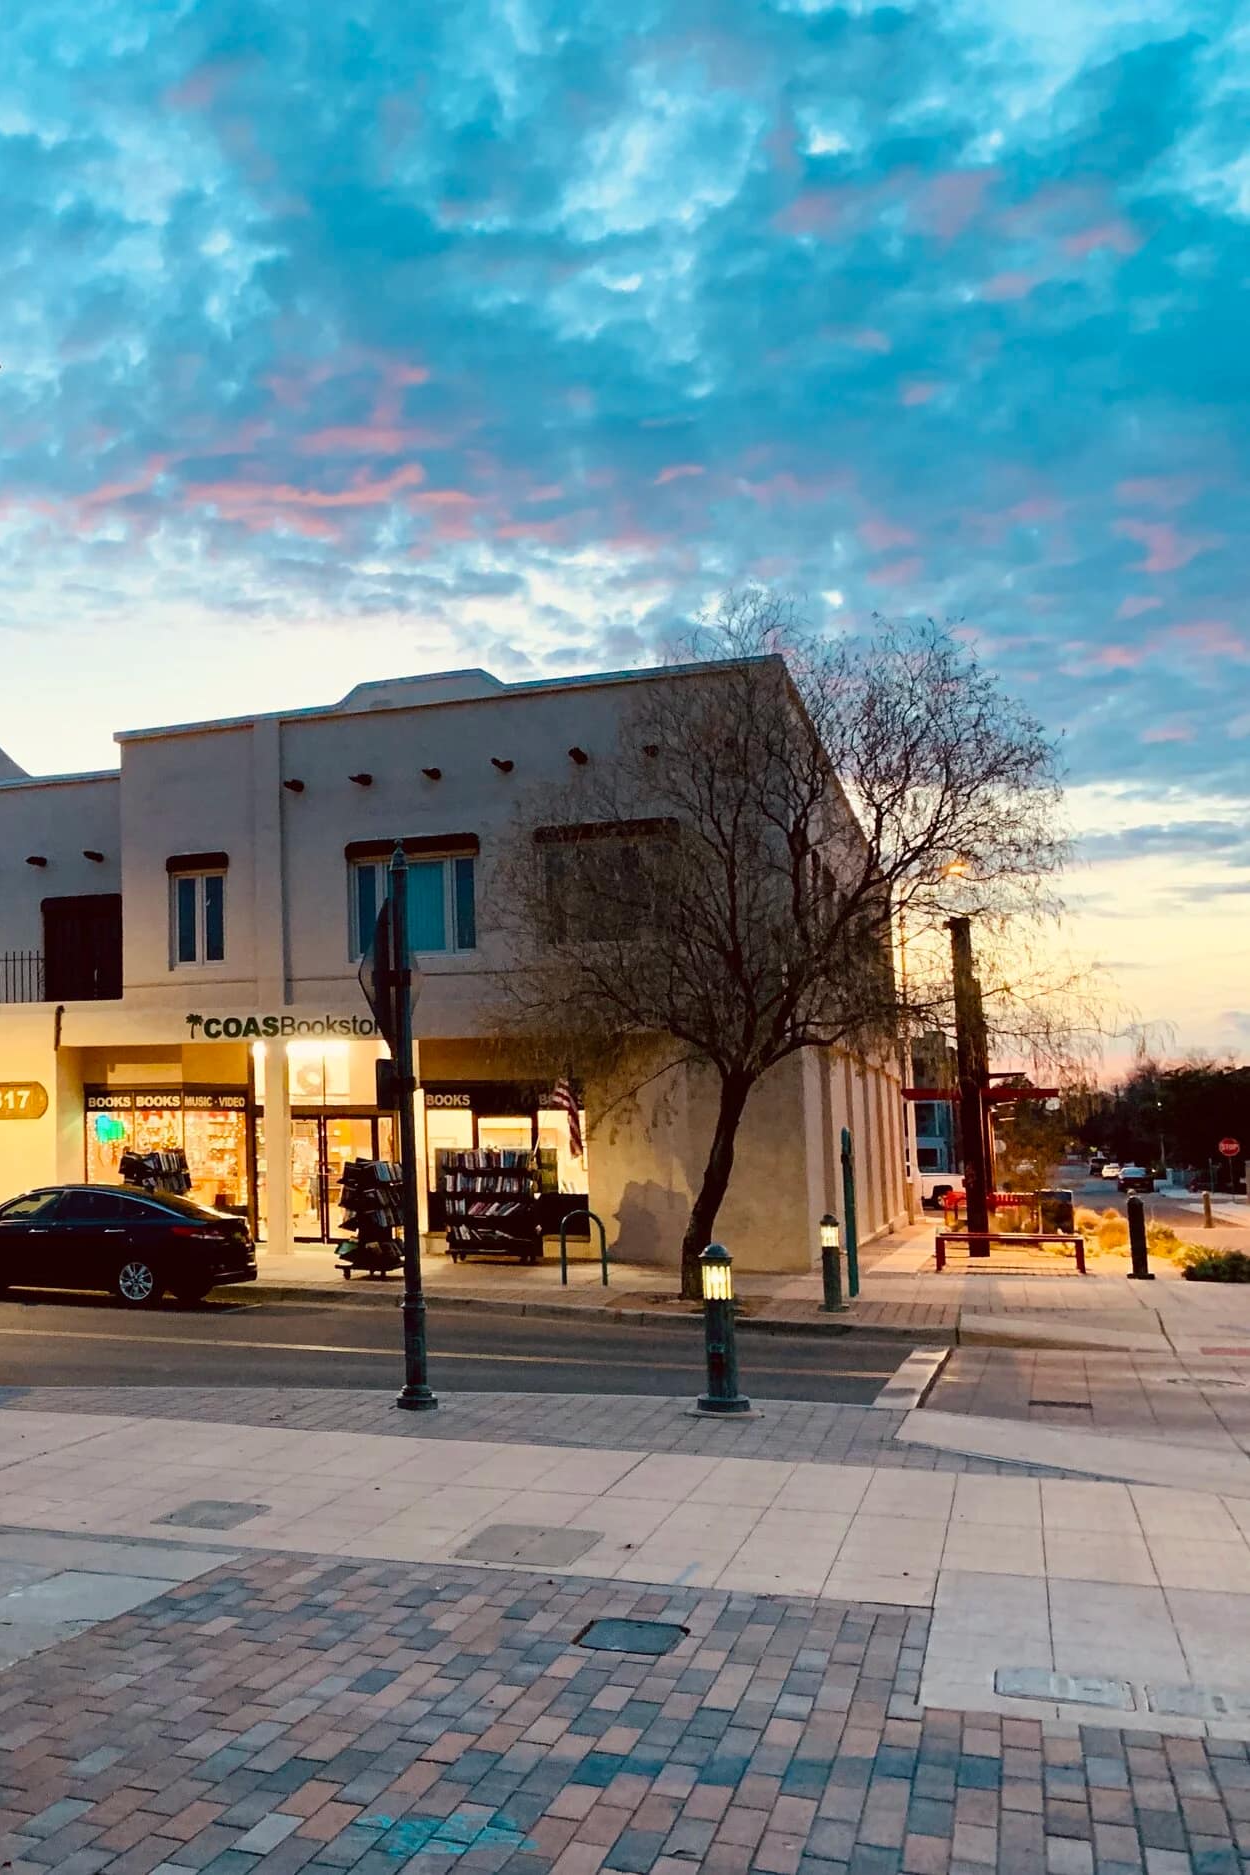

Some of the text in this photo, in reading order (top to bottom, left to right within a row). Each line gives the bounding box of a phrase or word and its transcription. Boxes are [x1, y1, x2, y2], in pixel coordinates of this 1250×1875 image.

[280, 1015, 382, 1038] Bookstor
[88, 1095, 246, 1108] BOOKS BOOKS MUSIC VIDEO
[426, 1094, 471, 1106] BOOKS
